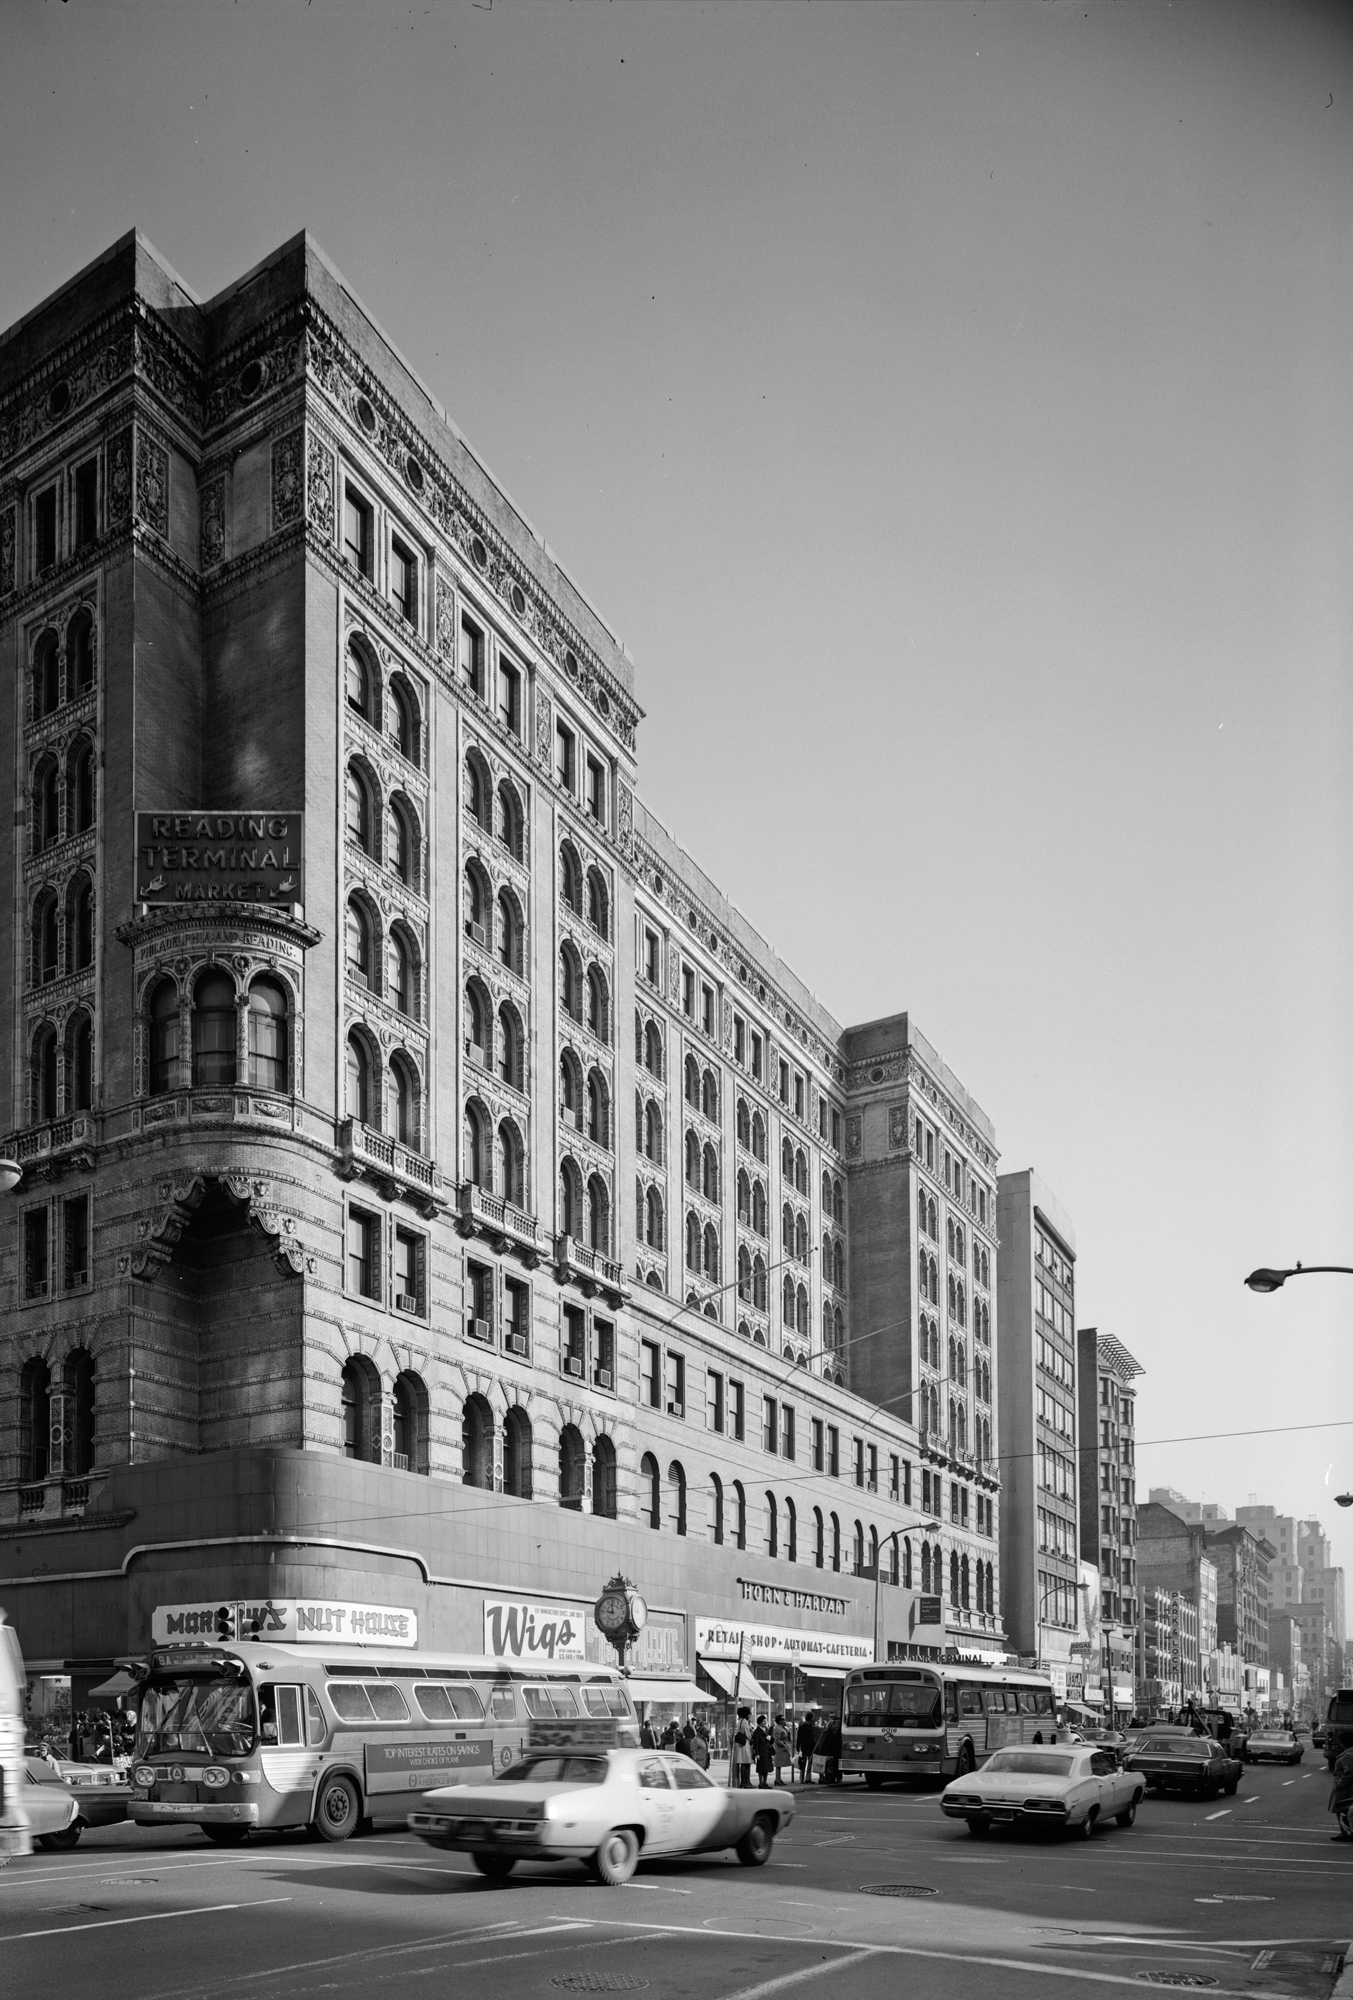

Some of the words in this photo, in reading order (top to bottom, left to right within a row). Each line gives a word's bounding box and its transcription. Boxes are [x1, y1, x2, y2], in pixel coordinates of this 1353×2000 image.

[152, 816, 288, 840] READING
[141, 846, 300, 870] TERMINAL
[175, 882, 266, 900] MARKET
[140, 931, 212, 960] PHILADELPHIA
[742, 1582, 780, 1605] HORN
[783, 1591, 792, 1607] &
[794, 1592, 848, 1615] HARDART
[1171, 1592, 1179, 1624] PARK
[166, 1601, 288, 1635] MORW'S
[296, 1607, 346, 1633] NUT
[351, 1610, 410, 1638] HOUSE
[486, 1605, 576, 1659] Wigs
[707, 1630, 743, 1645] RETAI
[750, 1634, 778, 1648] SHOP
[1172, 1628, 1178, 1636] &
[158, 1655, 172, 1666] 9A
[1171, 1639, 1179, 1672] LOCK
[384, 1748, 396, 1759] TOP
[397, 1747, 426, 1758] INTEREST
[427, 1746, 446, 1757] RATES
[446, 1746, 456, 1756] ON
[457, 1745, 480, 1755] SAVINGS
[409, 1758, 422, 1766] WIDE
[422, 1757, 439, 1765] CHOICE
[446, 1756, 460, 1764] PLANS
[417, 1778, 422, 1786] A
[422, 1776, 446, 1786] HERITAGE
[446, 1775, 460, 1784] BANK
